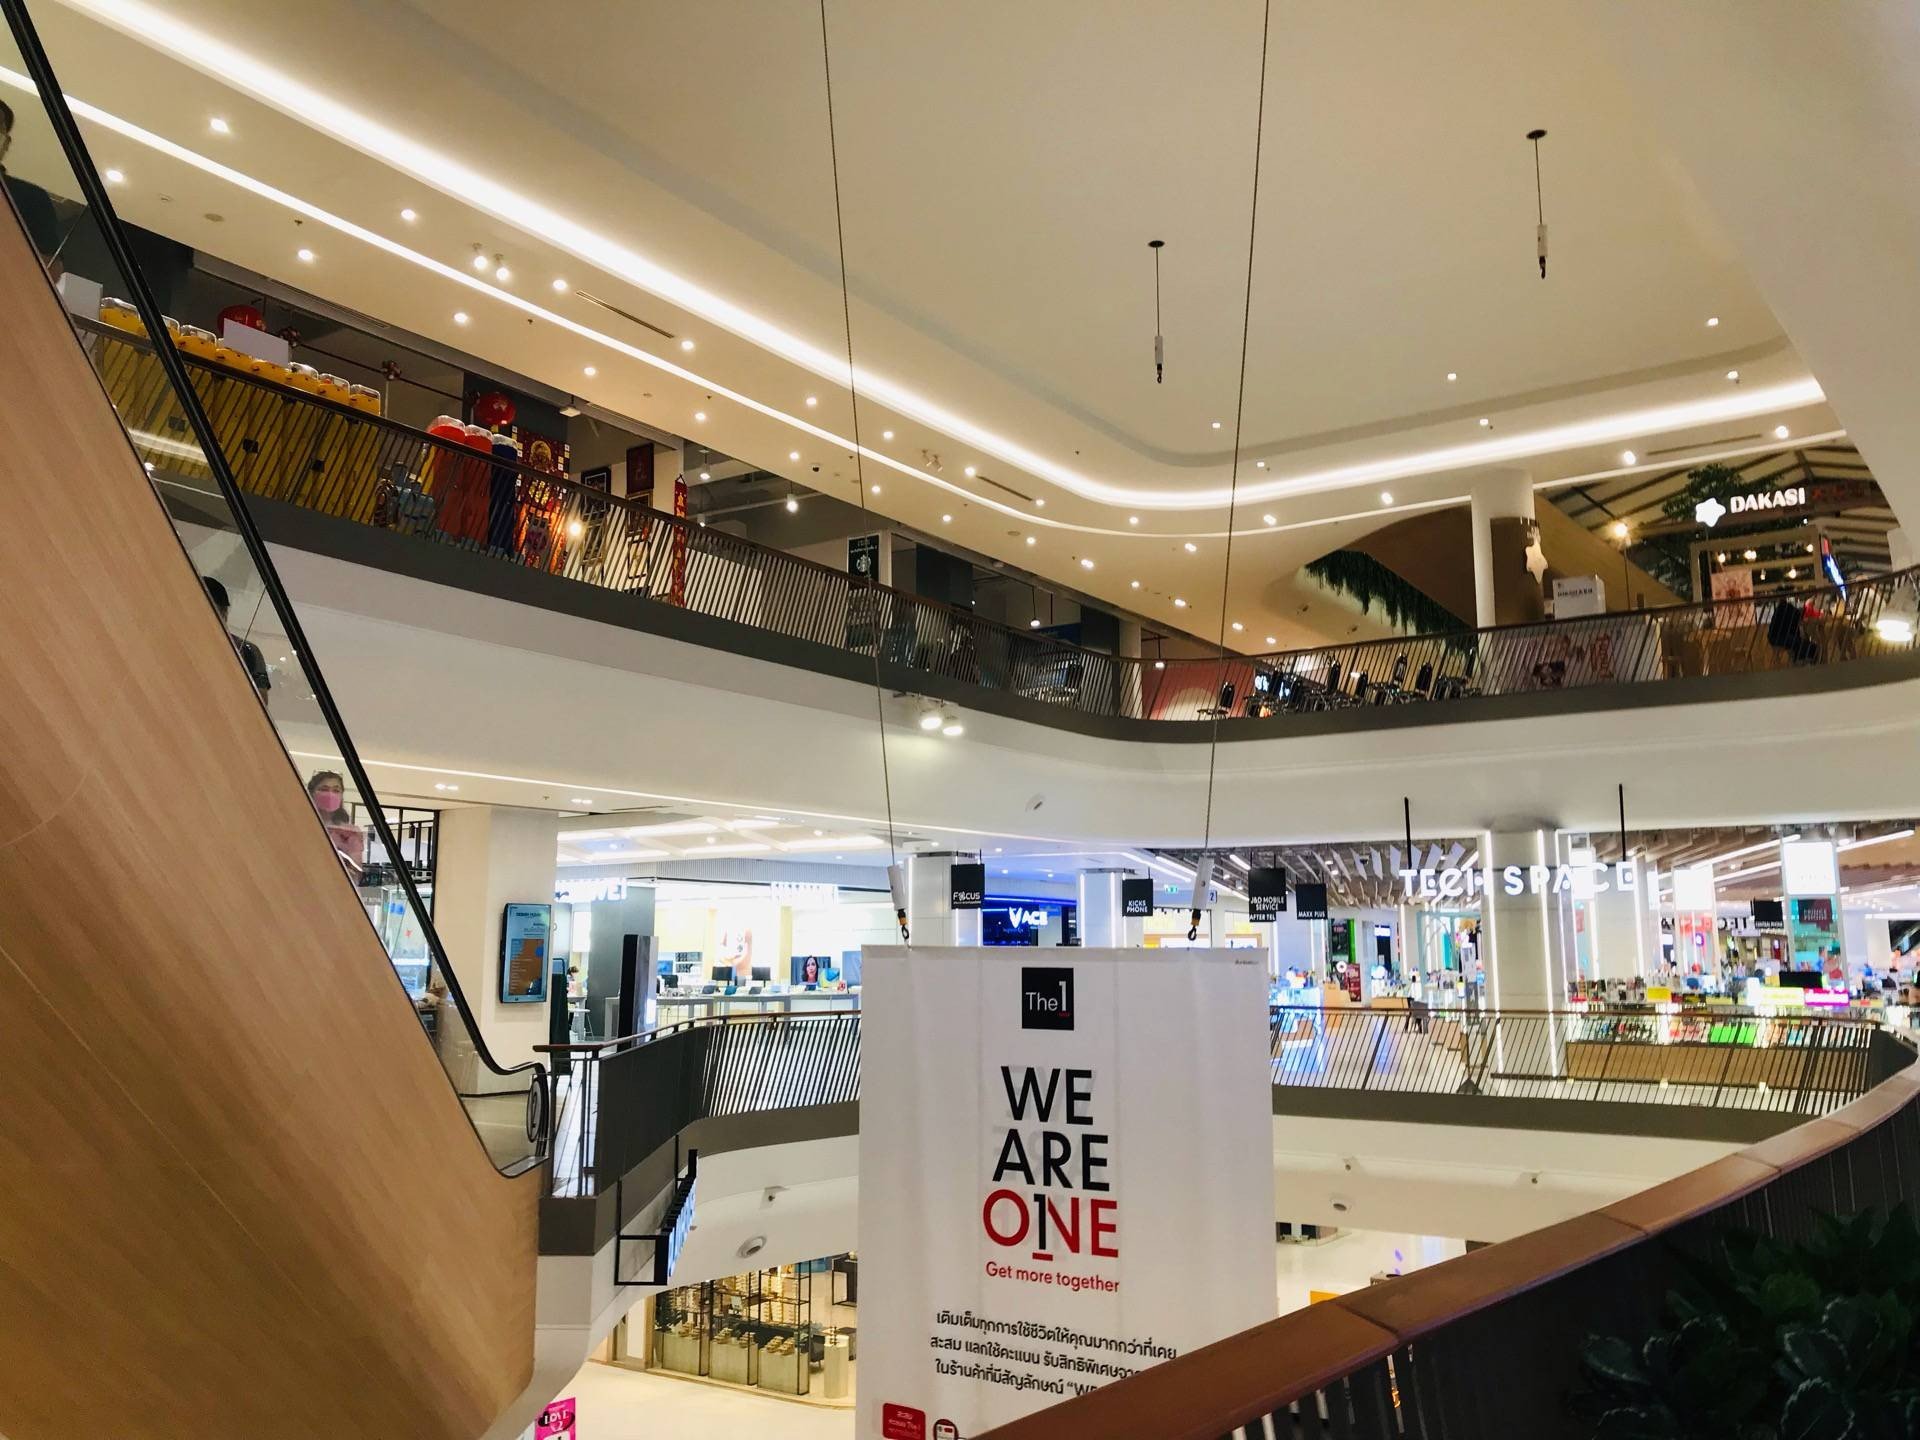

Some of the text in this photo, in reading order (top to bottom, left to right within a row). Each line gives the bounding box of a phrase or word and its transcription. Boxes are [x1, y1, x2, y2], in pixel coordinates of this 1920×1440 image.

[1730, 487, 1806, 514] DAKASI
[1263, 896, 1284, 904] MOBILE
[1399, 866, 1489, 906] TECH
[1255, 903, 1278, 911] SERVICE
[1000, 1065, 1093, 1125] WE
[992, 1128, 1110, 1191] ARE
[986, 1261, 1120, 1293] Get more together
[930, 1336, 1141, 1379] สะสม แลกใช้คะแนน รับสิทธิพิเศษจา
[935, 1358, 1064, 1395] ในร้านค้าที่มีสัญลักษณ์
